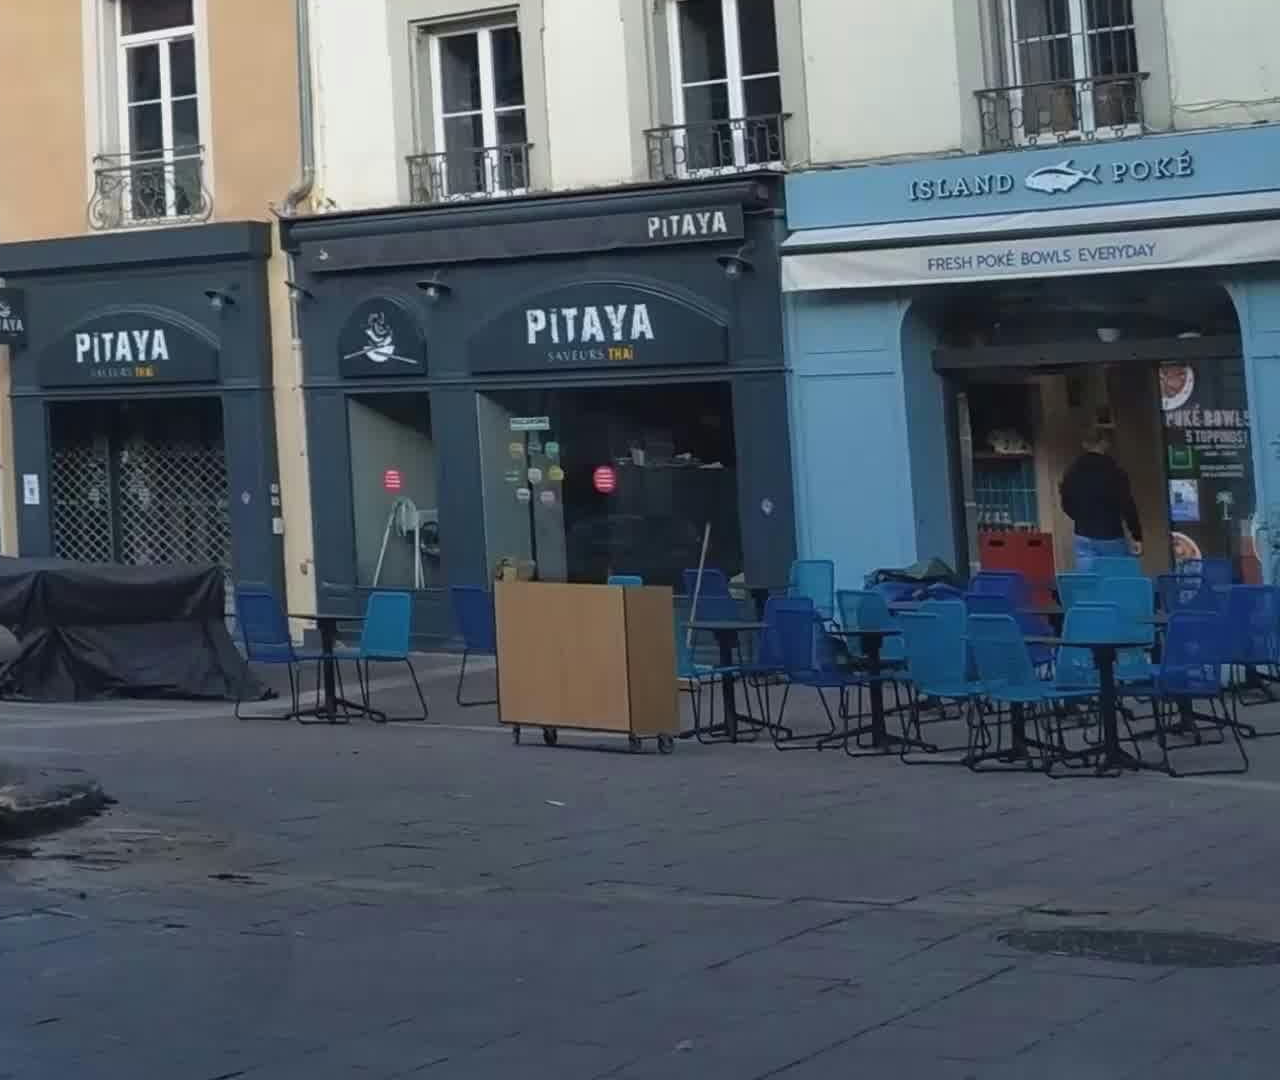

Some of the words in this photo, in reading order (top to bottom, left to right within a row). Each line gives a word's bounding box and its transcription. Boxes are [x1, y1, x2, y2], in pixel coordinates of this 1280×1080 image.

[907, 173, 1014, 201] ISLAND
[1112, 149, 1195, 183] POKÉ
[927, 255, 973, 271] FRESH
[977, 249, 1015, 269] POKÉ
[1020, 248, 1073, 266] BOWLS
[1078, 242, 1157, 263] EVERYDAY
[546, 348, 605, 361] SAVEURS
